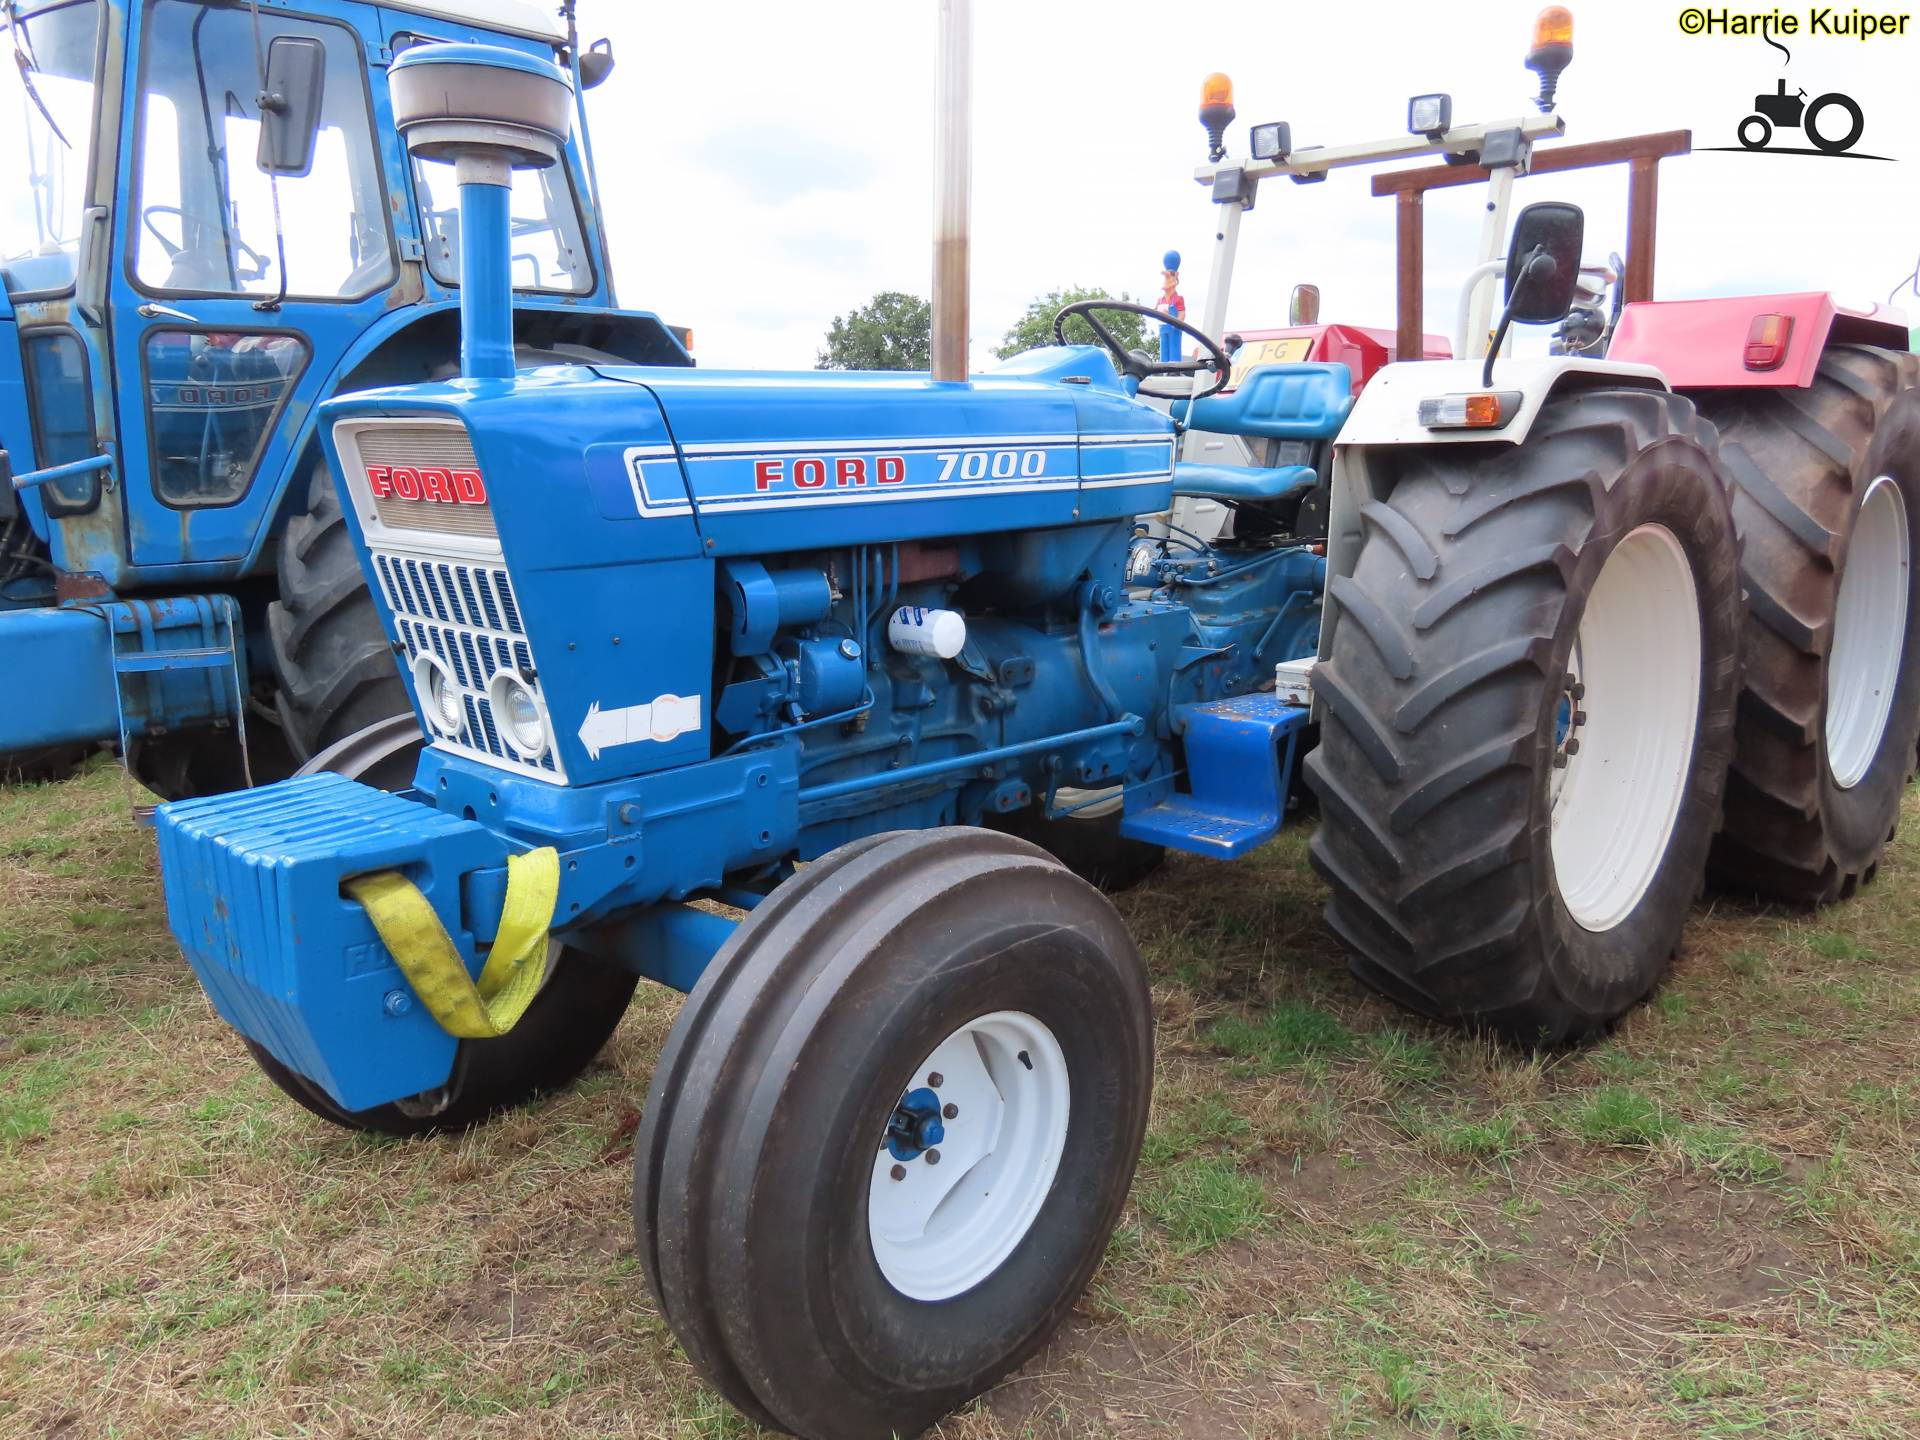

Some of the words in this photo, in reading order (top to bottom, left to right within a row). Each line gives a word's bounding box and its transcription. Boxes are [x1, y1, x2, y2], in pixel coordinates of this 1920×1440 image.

[366, 465, 488, 504] FORD
[754, 456, 906, 491] FORD
[936, 450, 1046, 481] 7000
